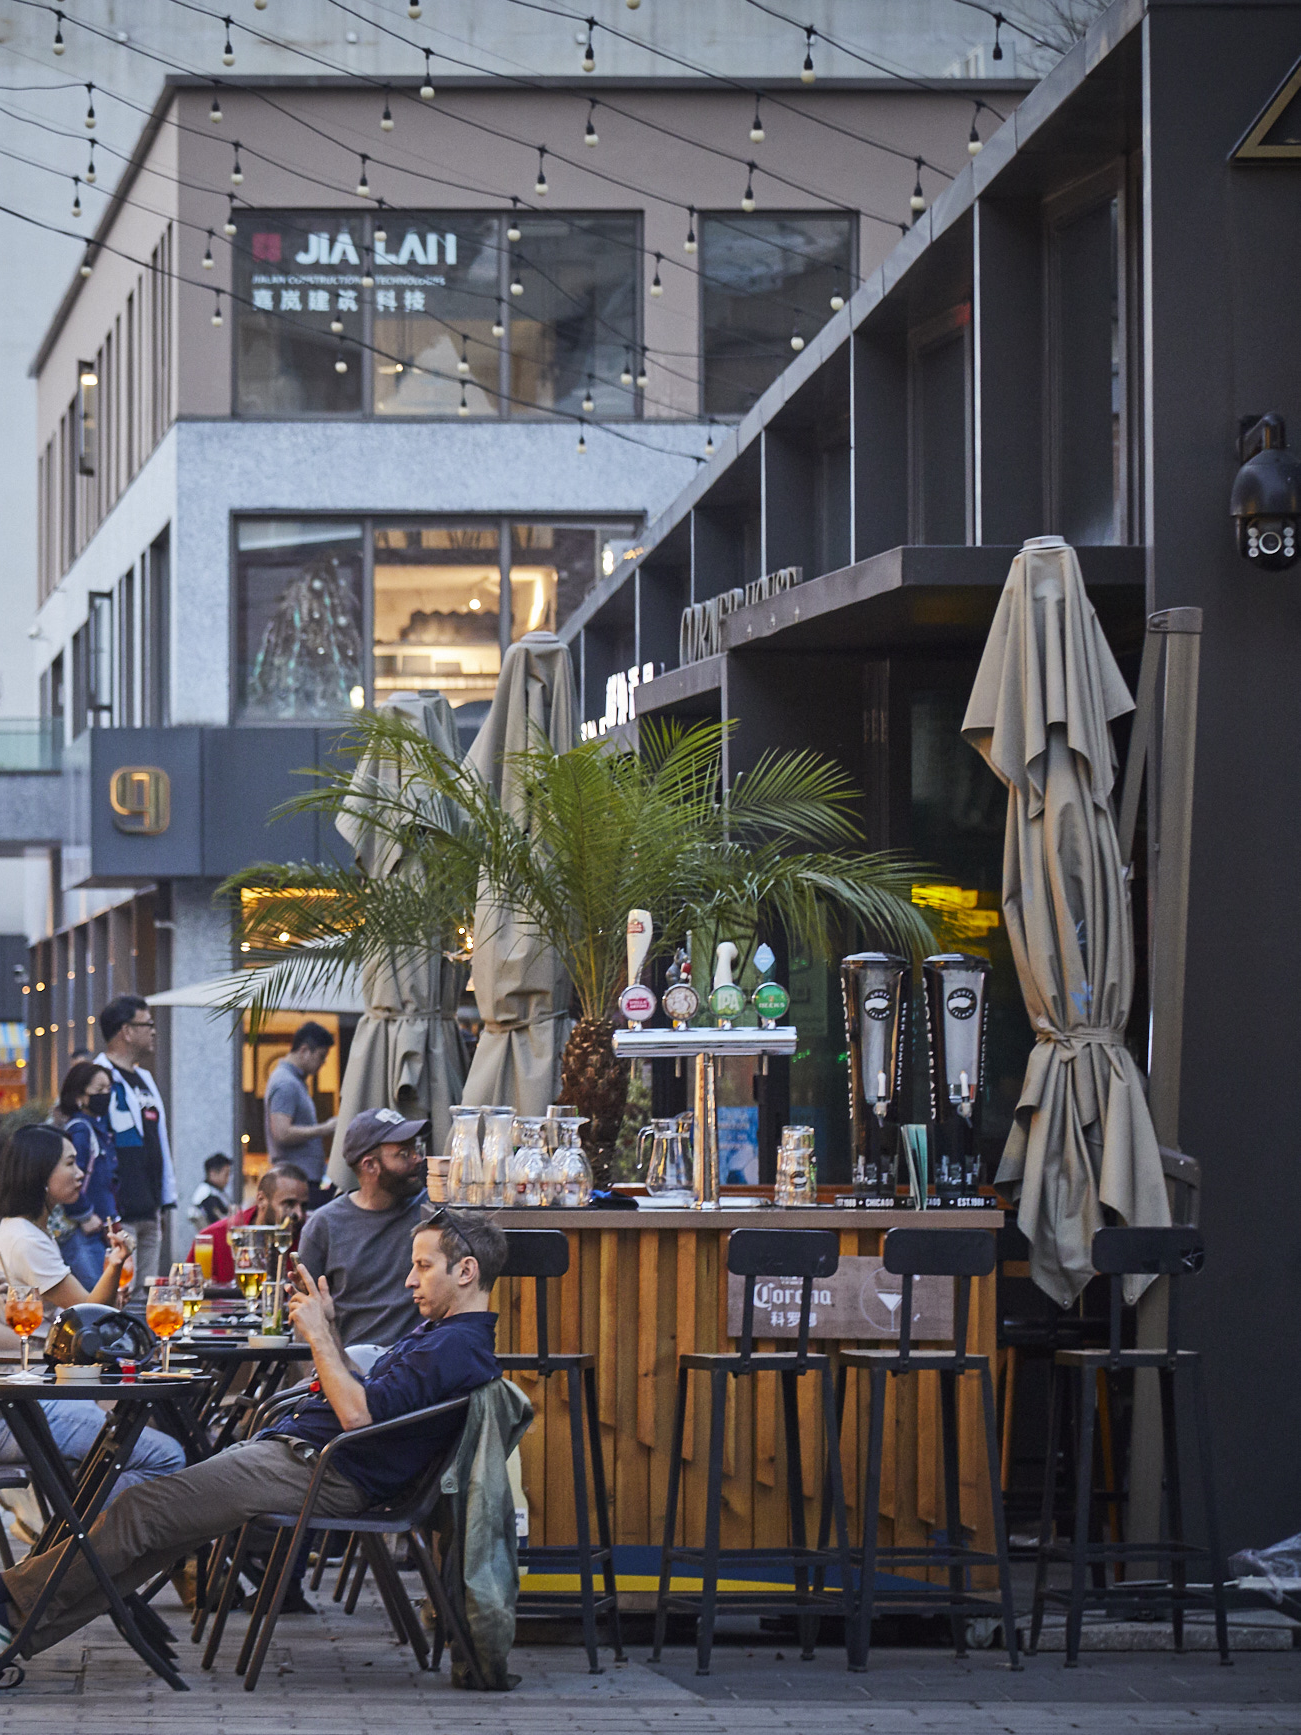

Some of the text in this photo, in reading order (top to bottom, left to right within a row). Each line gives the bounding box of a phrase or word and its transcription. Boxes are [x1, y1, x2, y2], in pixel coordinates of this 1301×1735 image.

[110, 766, 170, 835] 9
[717, 989, 740, 1011] IPA
[865, 1198, 895, 1208] CHICAGO
